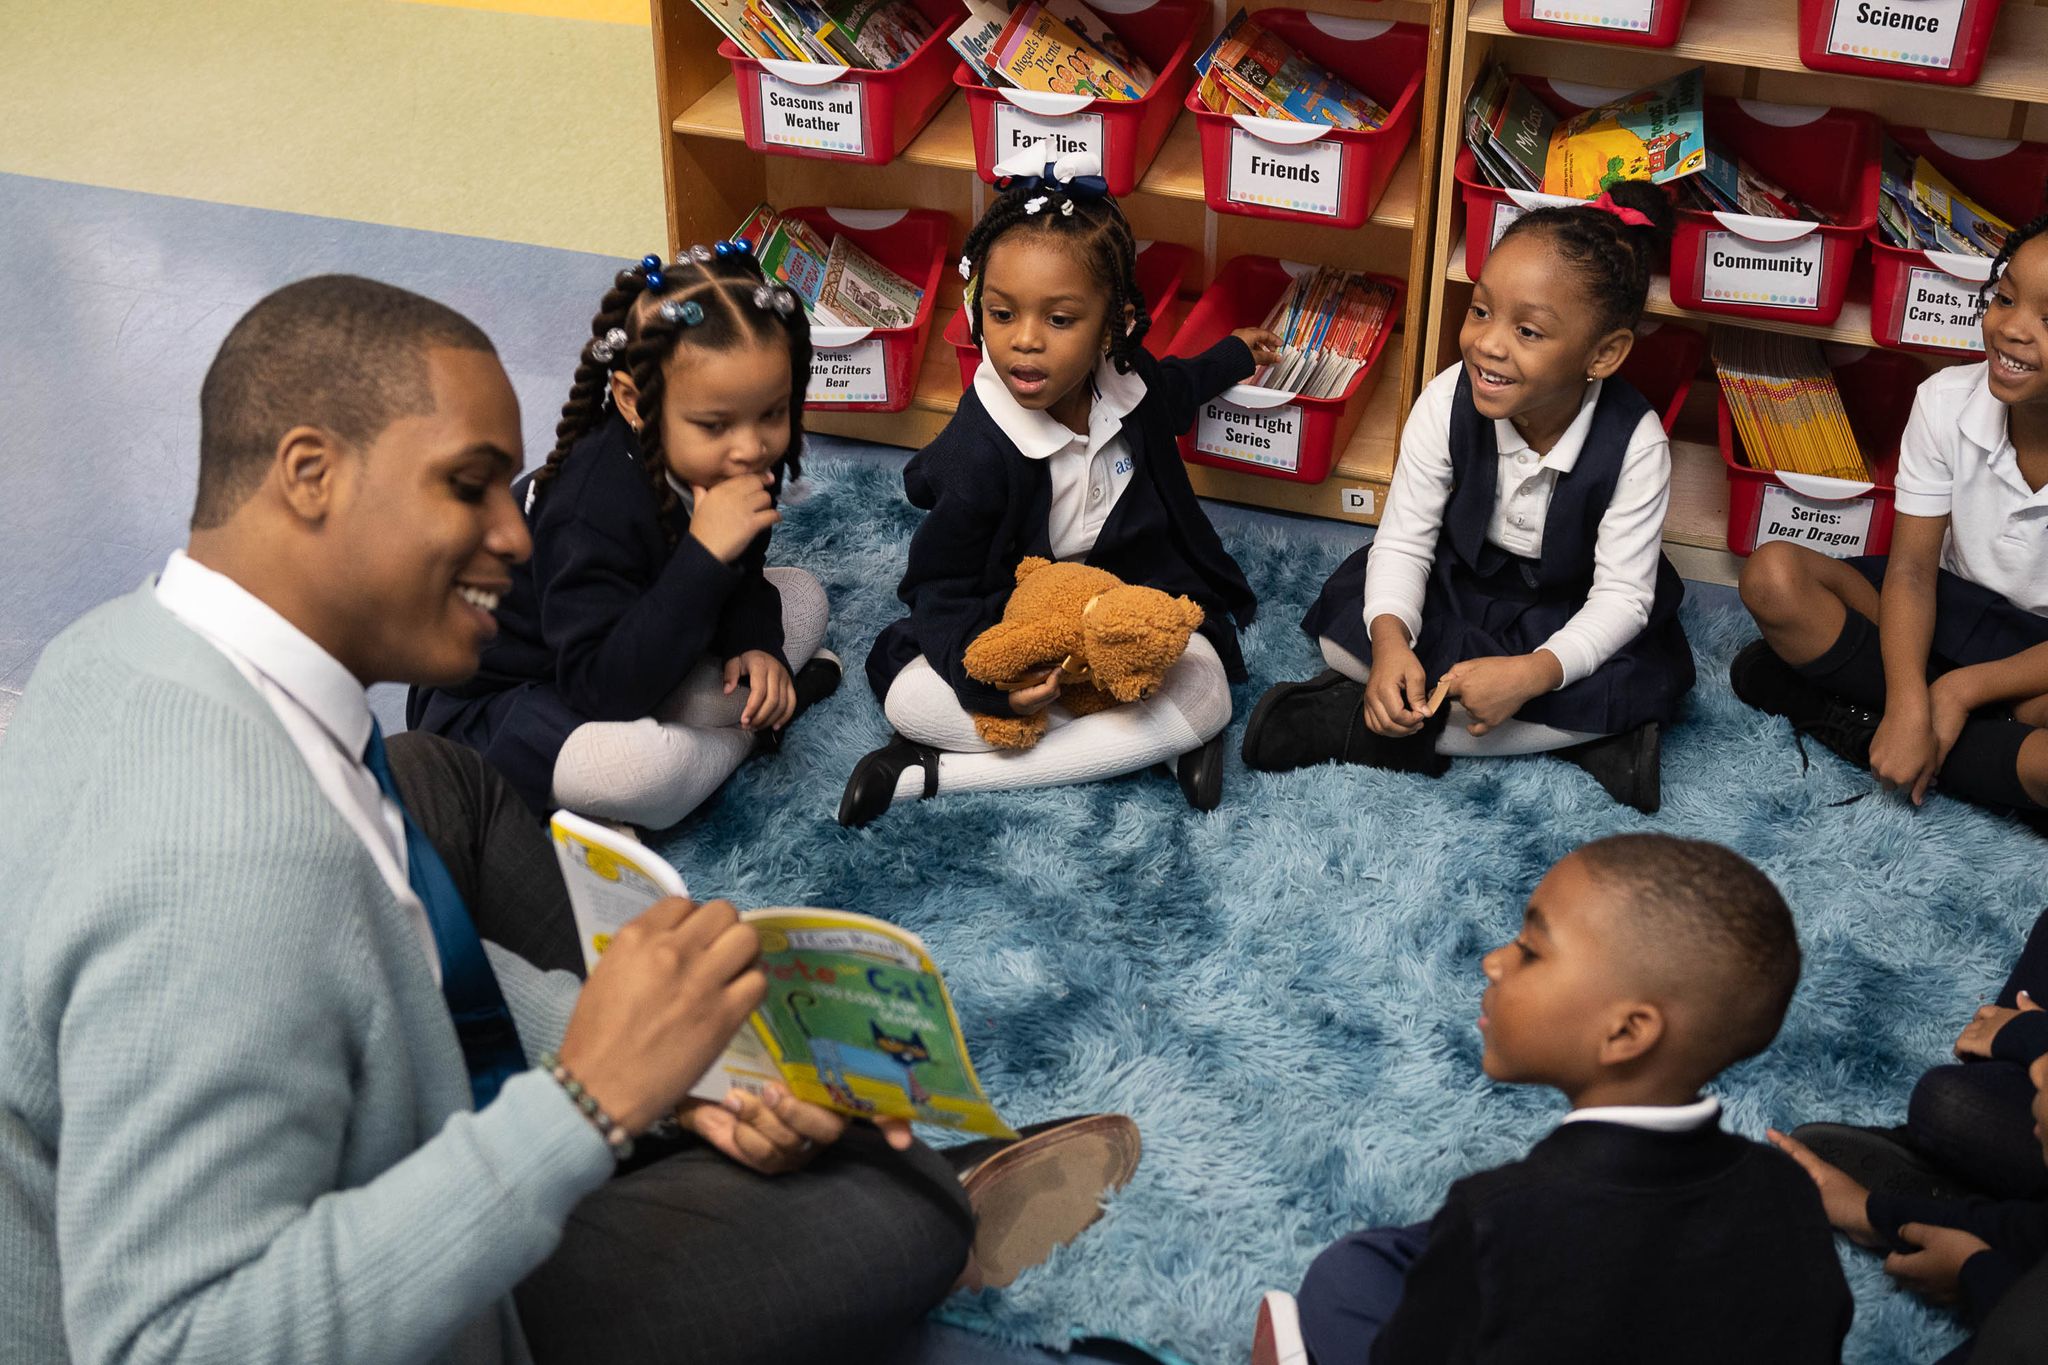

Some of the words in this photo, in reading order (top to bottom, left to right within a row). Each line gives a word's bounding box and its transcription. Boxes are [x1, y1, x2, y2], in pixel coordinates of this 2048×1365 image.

[1856, 2, 1939, 33] Science
[1012, 39, 1040, 76] Miguel's
[1035, 40, 1061, 74] Picnic
[770, 91, 824, 112] Seasons
[828, 99, 853, 115] and
[785, 112, 840, 133] Weather
[1012, 129, 1087, 153] Falies
[1516, 128, 1538, 155] My
[1251, 156, 1320, 184] Friends
[1712, 251, 1813, 277] Community
[1917, 288, 1961, 308] Boats,
[1909, 306, 1945, 325] Cars,
[1950, 314, 1977, 327] and
[816, 351, 852, 361] Series:
[810, 364, 829, 375] ttle
[831, 364, 871, 375] Critters
[825, 377, 850, 388] Bear
[1206, 404, 1250, 426] Green
[1254, 414, 1293, 435] Light
[1225, 427, 1271, 450] Series
[1115, 456, 1134, 475] as
[1350, 493, 1365, 507] D
[1791, 506, 1841, 524] Series:
[1768, 522, 1803, 538] Dear
[1806, 527, 1860, 545] Dragon
[760, 957, 838, 985] ete
[866, 967, 935, 1009] Cat
